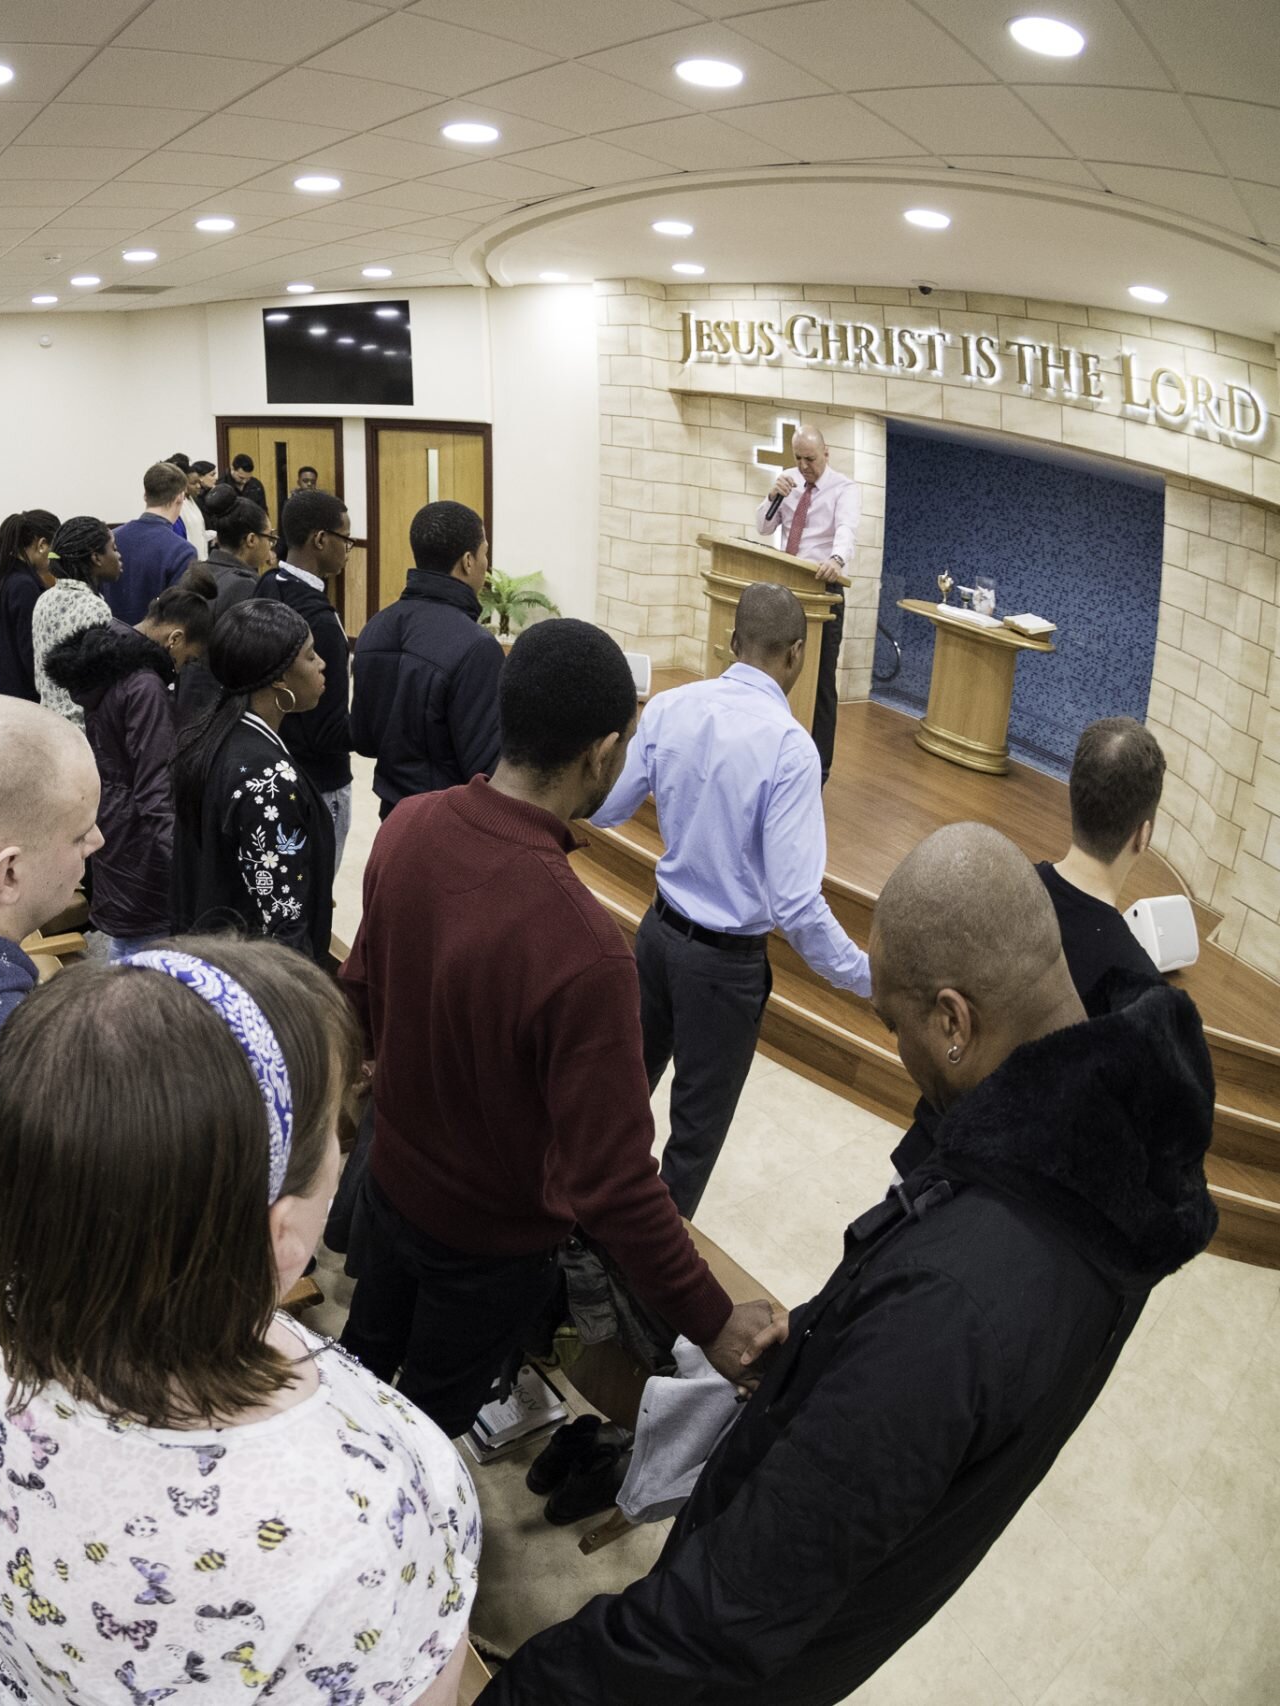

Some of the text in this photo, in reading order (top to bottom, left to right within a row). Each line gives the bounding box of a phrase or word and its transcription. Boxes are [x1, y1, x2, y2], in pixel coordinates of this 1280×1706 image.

[678, 312, 1262, 436] JESUS CHRIST IS THE LORD
